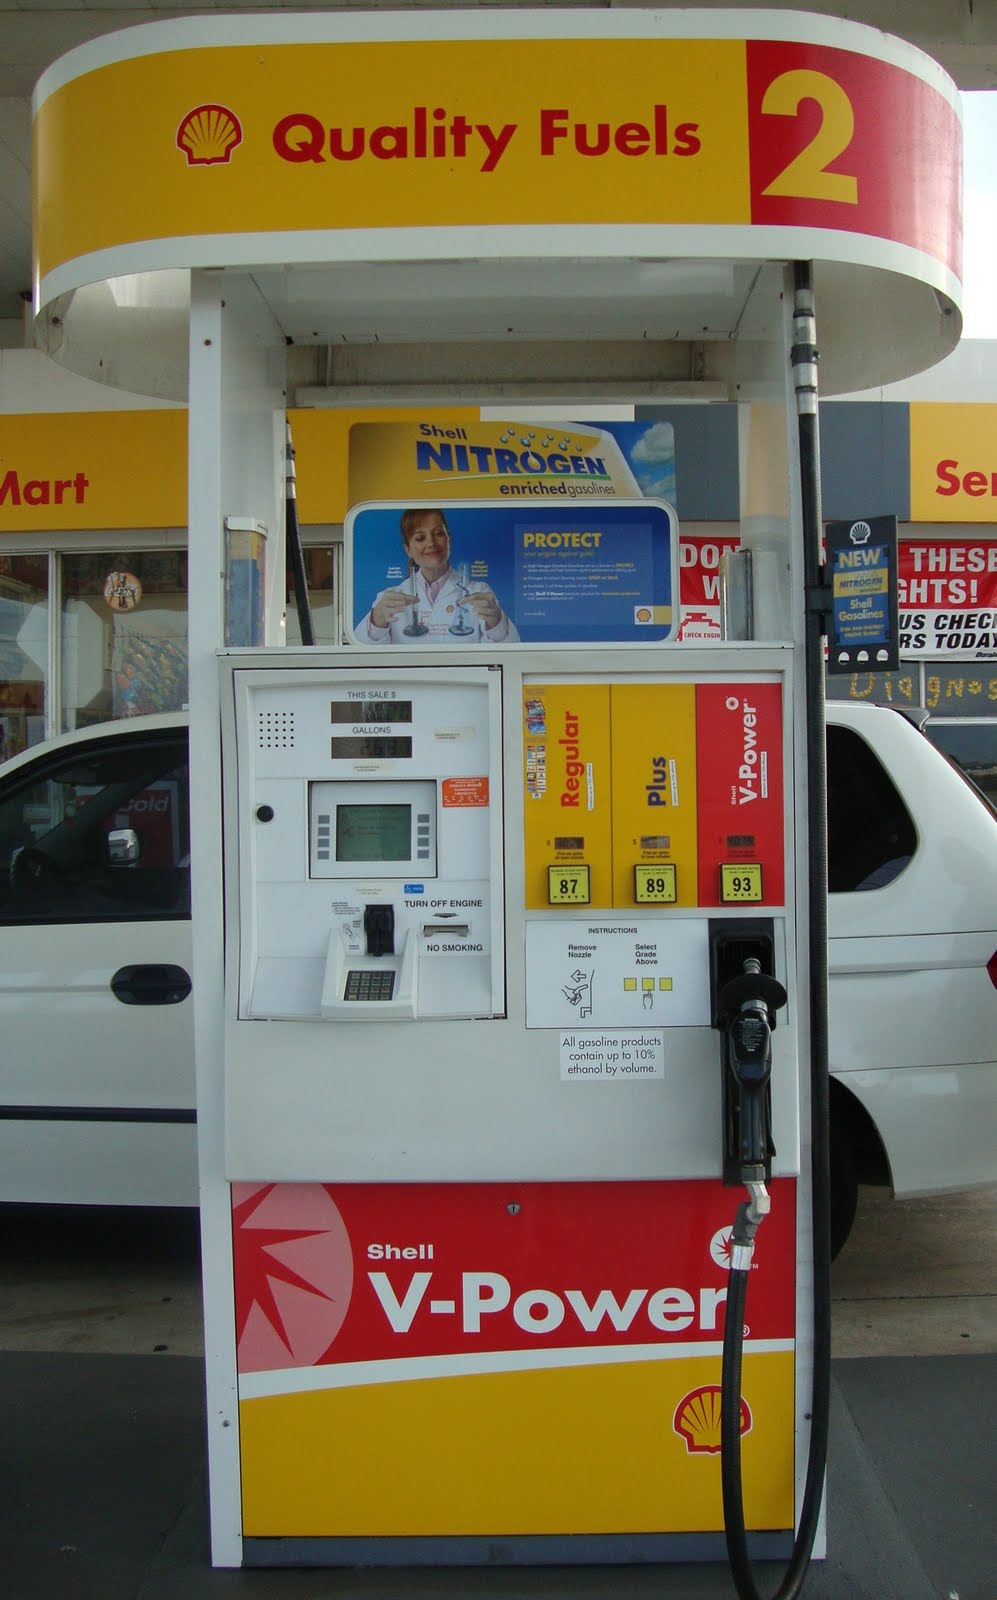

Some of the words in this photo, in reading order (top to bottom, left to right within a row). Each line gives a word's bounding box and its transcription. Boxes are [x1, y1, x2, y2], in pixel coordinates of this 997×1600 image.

[272, 107, 517, 172] Quality
[540, 104, 701, 157] Fuels
[760, 69, 858, 205] 2
[419, 423, 468, 440] Shell
[416, 441, 607, 475] NITROGEN
[523, 532, 602, 548] PROTECT
[838, 547, 881, 569] NEW
[909, 547, 997, 573] THESE
[839, 576, 883, 589] NITROGEN
[850, 597, 872, 610] Shell
[838, 609, 884, 622] Gasolines
[934, 612, 997, 631] CHEC
[899, 633, 927, 648] RS
[348, 691, 366, 699] THIS
[368, 691, 388, 699] SALE
[391, 691, 397, 699] $
[558, 711, 585, 807] Regular
[739, 704, 758, 805] V-Power
[646, 757, 667, 806] Plus
[560, 879, 579, 894] 87
[646, 878, 665, 893] 89
[732, 877, 751, 892] 93
[405, 899, 428, 908] TURN
[430, 899, 447, 908] OFF
[449, 899, 483, 908] ENGINE
[427, 944, 439, 952] NO
[442, 944, 483, 952] SMOKING
[562, 1036, 576, 1047] All
[578, 1036, 618, 1049] gasoline
[621, 1036, 661, 1048] products
[569, 1050, 603, 1060] contain
[607, 1053, 619, 1062] up
[622, 1051, 631, 1060] to
[635, 1050, 655, 1060] 10%
[567, 1064, 602, 1074] ethanol
[605, 1063, 617, 1076] by
[620, 1063, 656, 1073] volume.
[367, 1244, 434, 1260] Shell
[367, 1272, 728, 1334] V-Power
